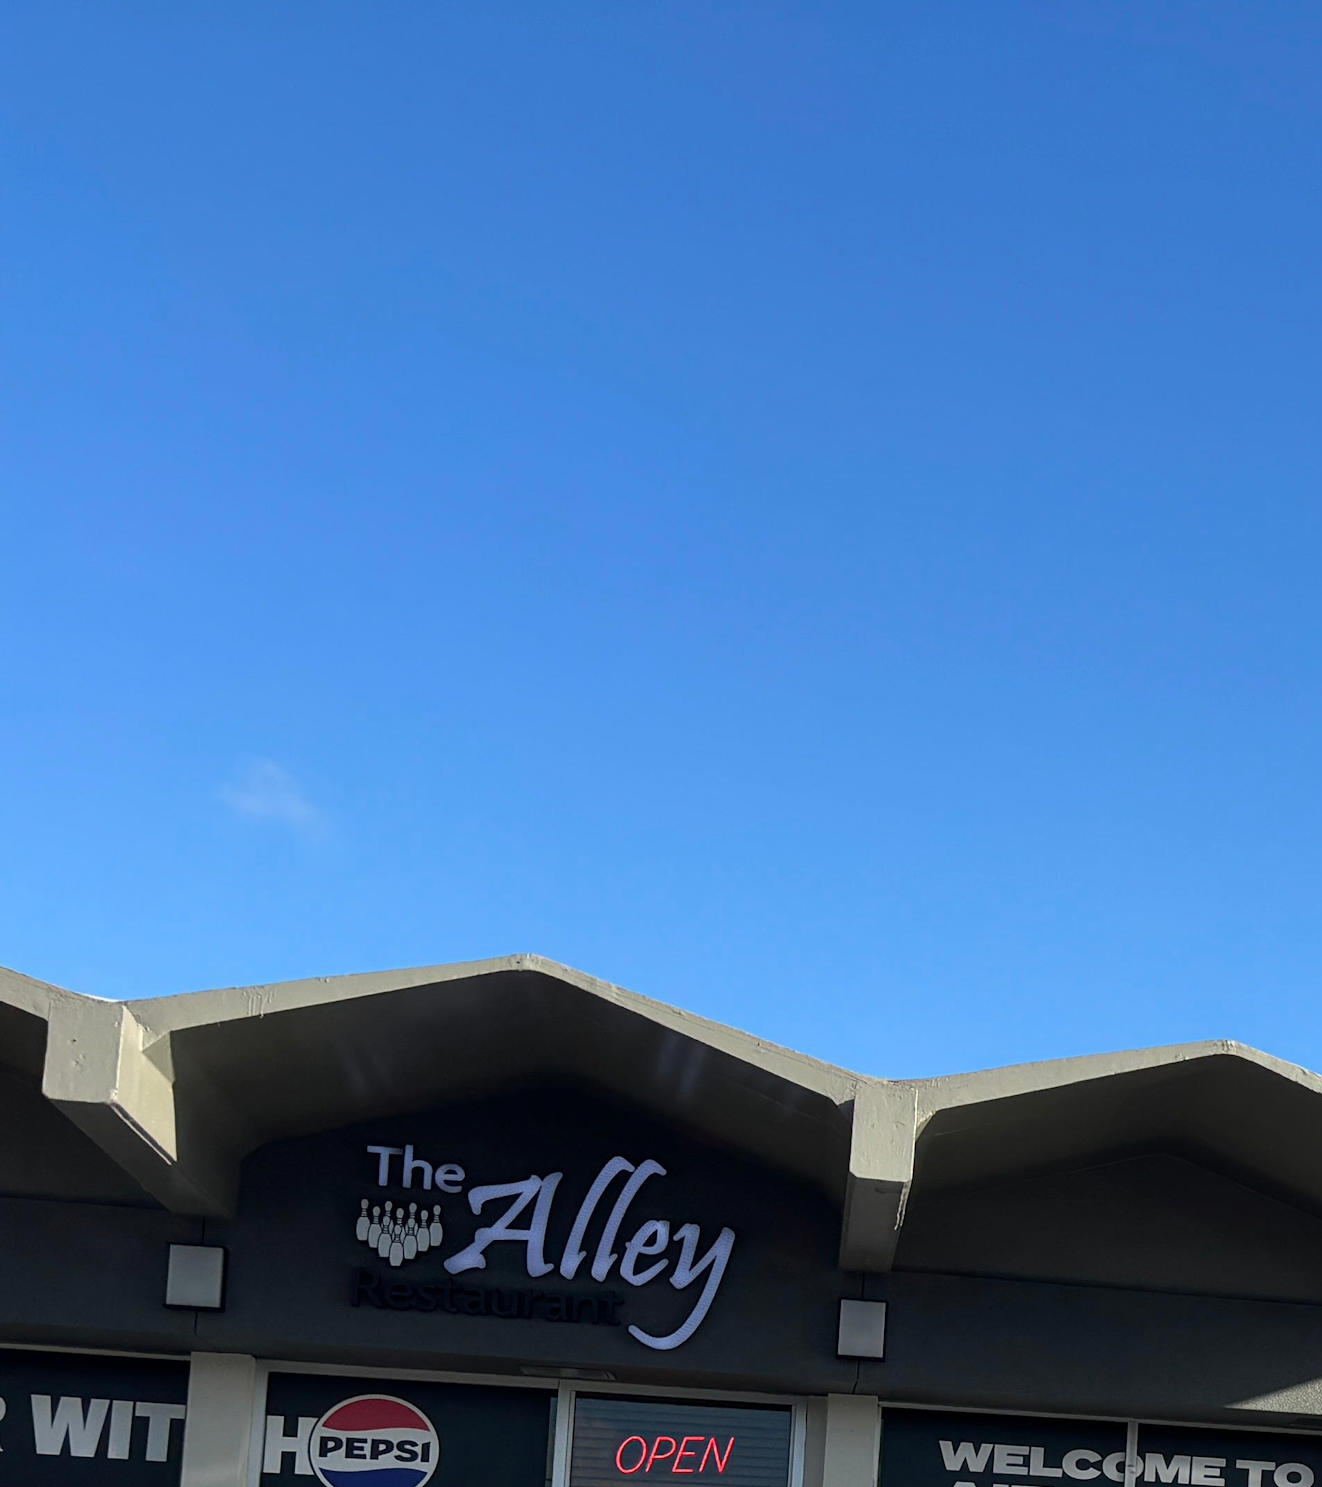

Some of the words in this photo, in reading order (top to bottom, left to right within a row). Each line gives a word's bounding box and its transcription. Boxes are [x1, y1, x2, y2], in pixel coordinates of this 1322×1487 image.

[366, 1144, 466, 1193] The
[443, 1156, 736, 1350] Alley
[318, 1436, 431, 1463] PEPSI
[615, 1435, 736, 1474] OPEN
[938, 1440, 1227, 1487] WELCOME
